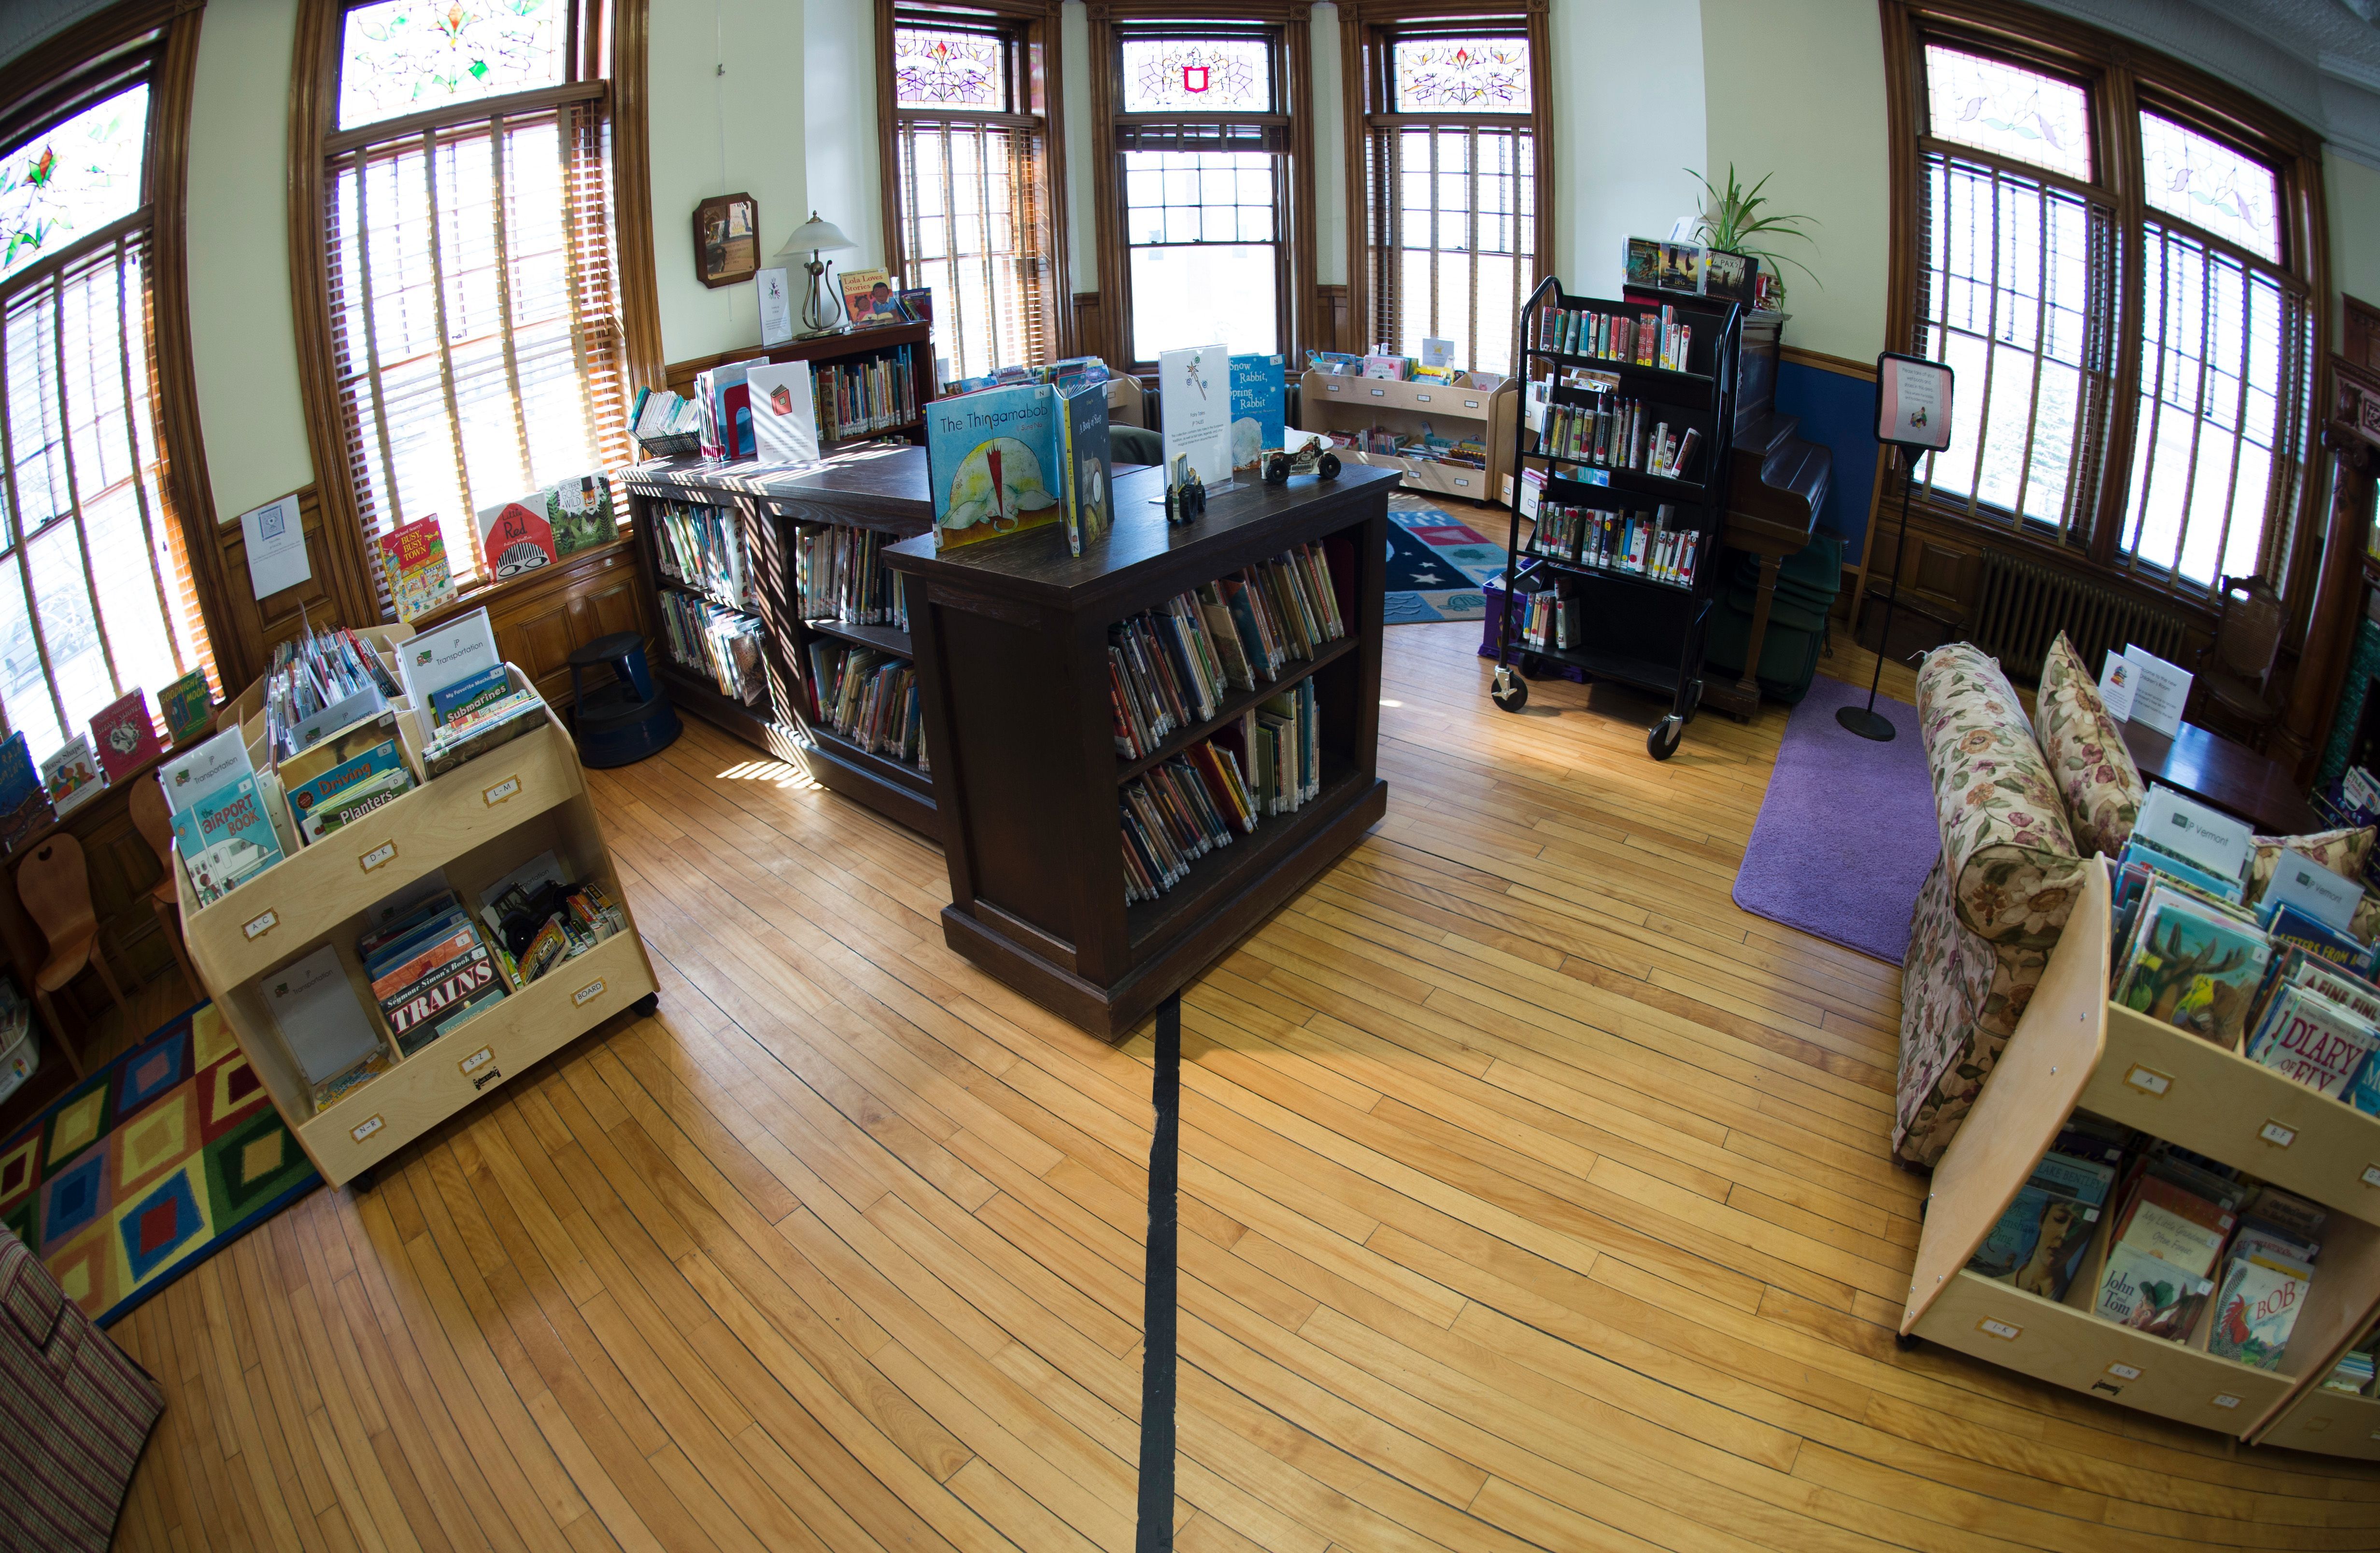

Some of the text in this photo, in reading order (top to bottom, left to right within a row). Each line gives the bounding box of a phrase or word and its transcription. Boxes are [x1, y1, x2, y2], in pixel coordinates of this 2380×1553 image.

[843, 274, 883, 286] Lola Loves
[845, 283, 871, 292] Stories
[1674, 277, 1685, 285] BFG
[1229, 360, 1251, 371] Snow
[1239, 371, 1267, 383] Rabbit,
[1240, 397, 1265, 409] Rabbit
[940, 401, 1048, 433] The Thingamabob
[1021, 422, 1033, 430] Sung
[1079, 424, 1083, 435] A
[1091, 418, 1094, 427] of
[562, 487, 580, 499] GOES
[567, 480, 580, 490] TIGER
[564, 497, 581, 509] WILD
[501, 508, 523, 521] Little
[395, 523, 423, 538] Richard Scarry's
[503, 517, 528, 540] Red
[401, 530, 422, 545] BUSY,
[403, 538, 422, 553] BUSY
[404, 546, 426, 561] TOWN
[436, 641, 483, 666] Transportation
[161, 678, 199, 704] GOODNIGHT
[186, 684, 207, 703] MOON
[453, 682, 475, 696] Favorite
[447, 684, 508, 723] Submarines
[62, 743, 85, 760] Shapes
[194, 757, 238, 785] Transportation
[318, 762, 372, 795] Driving
[201, 808, 213, 819] the
[340, 789, 394, 825] Planters
[227, 807, 260, 836] BOOK
[2196, 824, 2229, 846] Vermont
[2316, 884, 2342, 903] Vermont
[2322, 943, 2350, 963] FROM
[293, 969, 333, 995] Transportation
[387, 984, 420, 1008] Seymour
[421, 969, 450, 987] Simon's
[451, 956, 470, 971] Book
[2305, 974, 2316, 986] A
[390, 958, 493, 1034] TRAINS
[577, 983, 602, 1000] BOARD
[2280, 1017, 2364, 1075] DIARY
[2281, 1059, 2297, 1073] OF
[2145, 1076, 2153, 1085] A
[2062, 1170, 2101, 1189] BENTLEY
[2142, 1210, 2175, 1231] My Little
[2101, 1269, 2135, 1297] John
[2103, 1290, 2131, 1316] Tom
[2255, 1281, 2295, 1321] BOB
